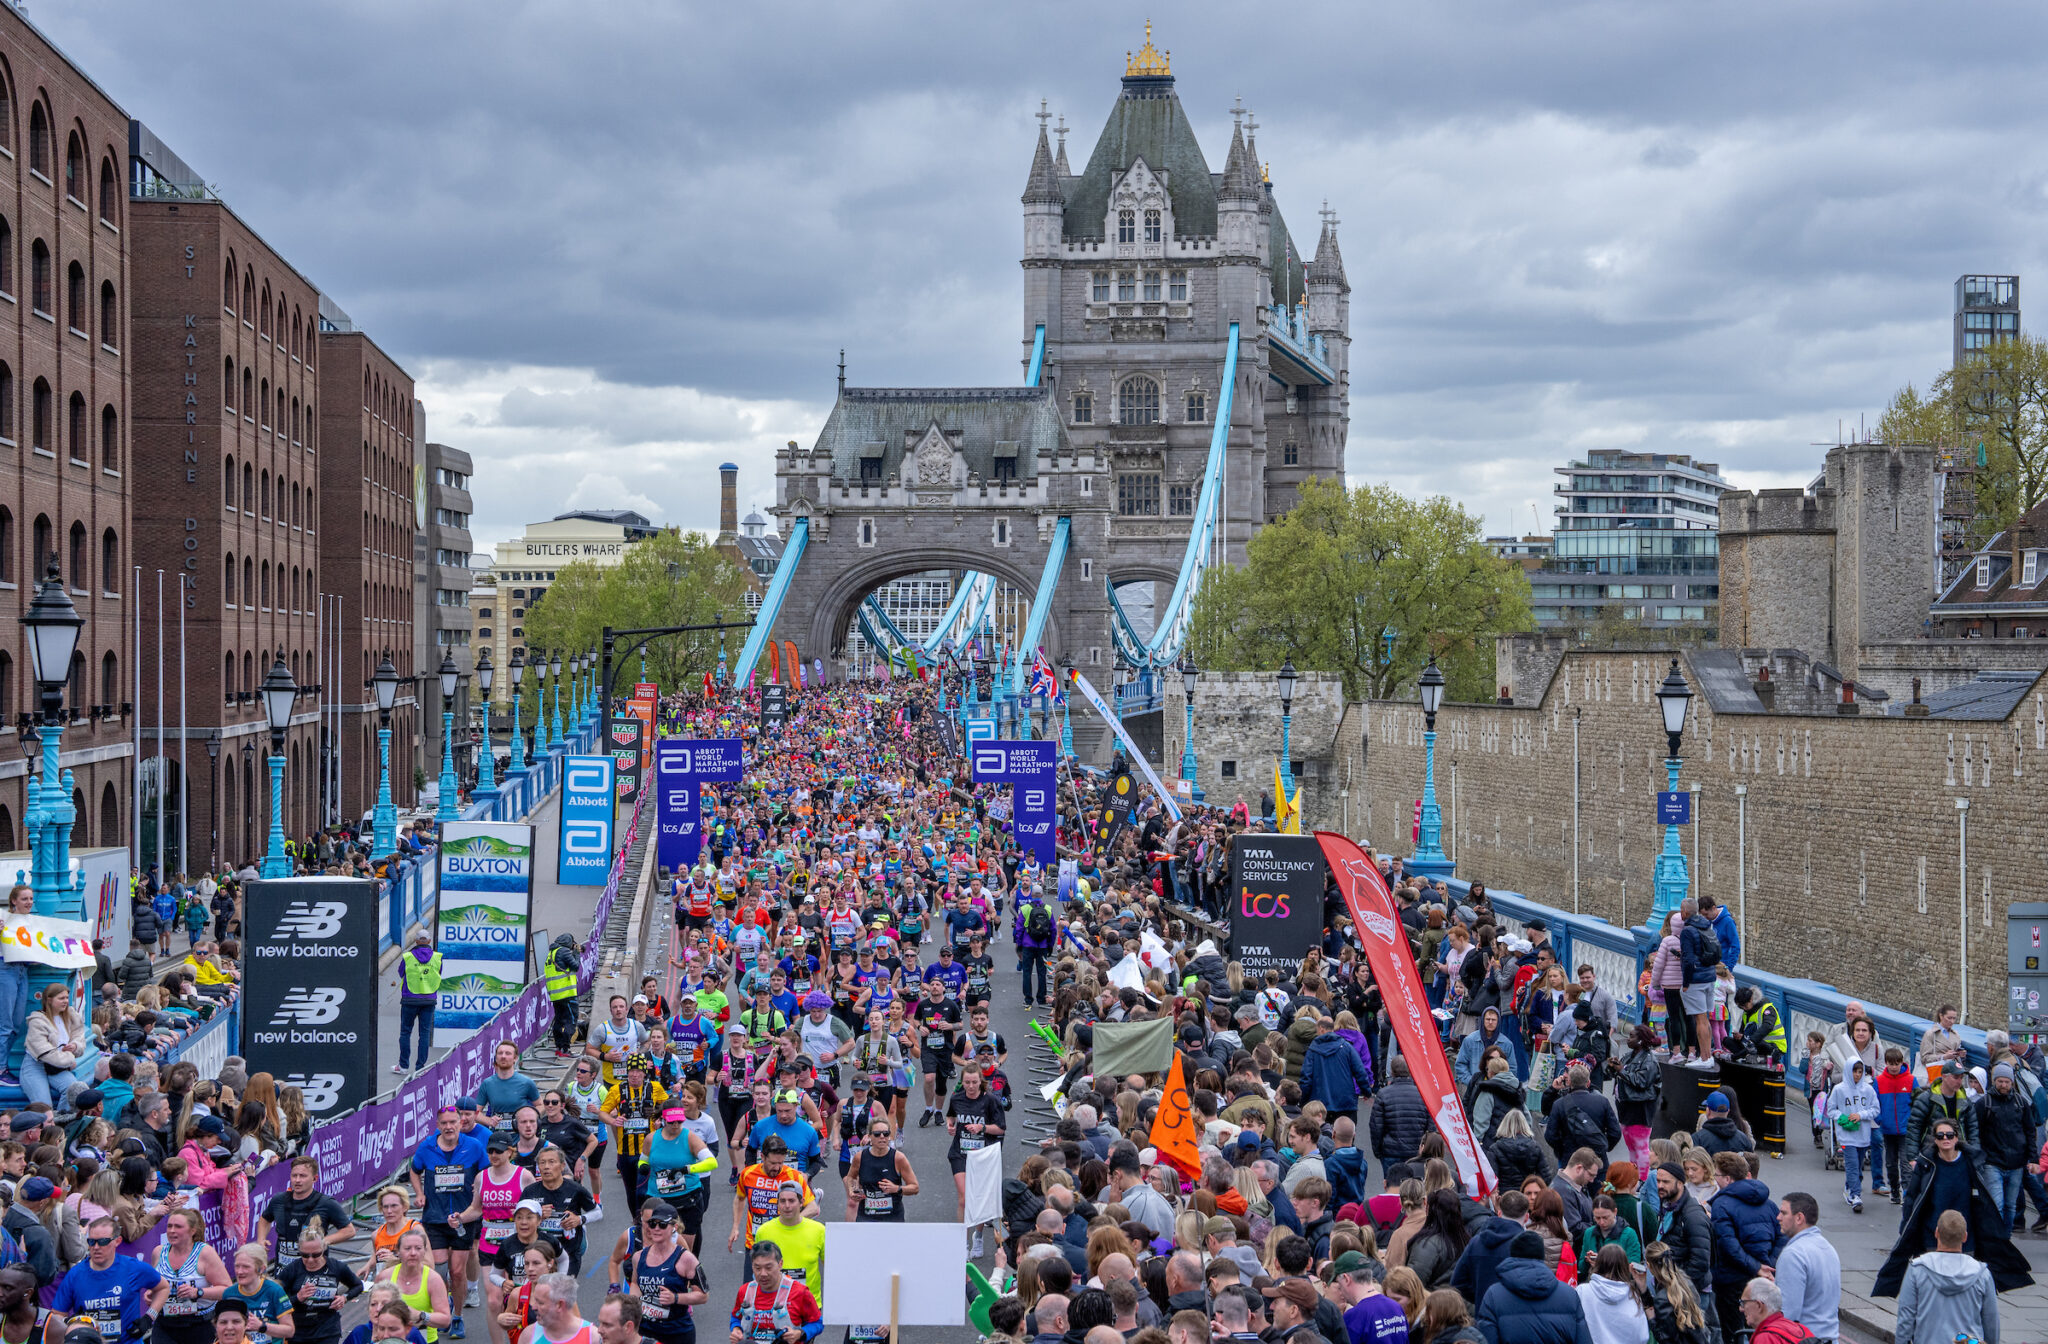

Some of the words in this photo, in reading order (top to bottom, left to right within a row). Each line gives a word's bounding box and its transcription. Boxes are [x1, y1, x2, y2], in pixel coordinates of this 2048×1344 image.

[184, 245, 196, 278] ST
[184, 314, 198, 482] KATHARINE
[526, 544, 578, 556] BUTLER'S
[583, 544, 623, 556] WHARF
[184, 518, 198, 608] DOCKS
[614, 725, 635, 733] TAG
[568, 796, 608, 807] Abbott
[1111, 795, 1130, 806] Shine
[1173, 793, 1190, 805] rdan
[662, 823, 678, 833] tcs
[1018, 822, 1033, 833] tcs
[1243, 849, 1274, 859] TATA
[448, 857, 522, 875] BUXTON
[565, 856, 606, 867] Abbott
[1243, 860, 1315, 871] CONSULTANCY
[1242, 871, 1288, 882] SERVICES
[1241, 886, 1290, 919] tcs
[445, 926, 518, 943] BUXTON
[255, 945, 288, 957] new
[292, 943, 359, 957] balance
[1240, 945, 1272, 956] TATA
[254, 1031, 287, 1044] new
[290, 1030, 358, 1044] balance
[1845, 1095, 1867, 1107] AFC
[957, 1114, 985, 1125] MAYA
[482, 1190, 513, 1201] ROSS
[752, 1196, 768, 1204] WITH
[639, 1275, 665, 1286] TEAM
[84, 1296, 121, 1310] WESTIE
